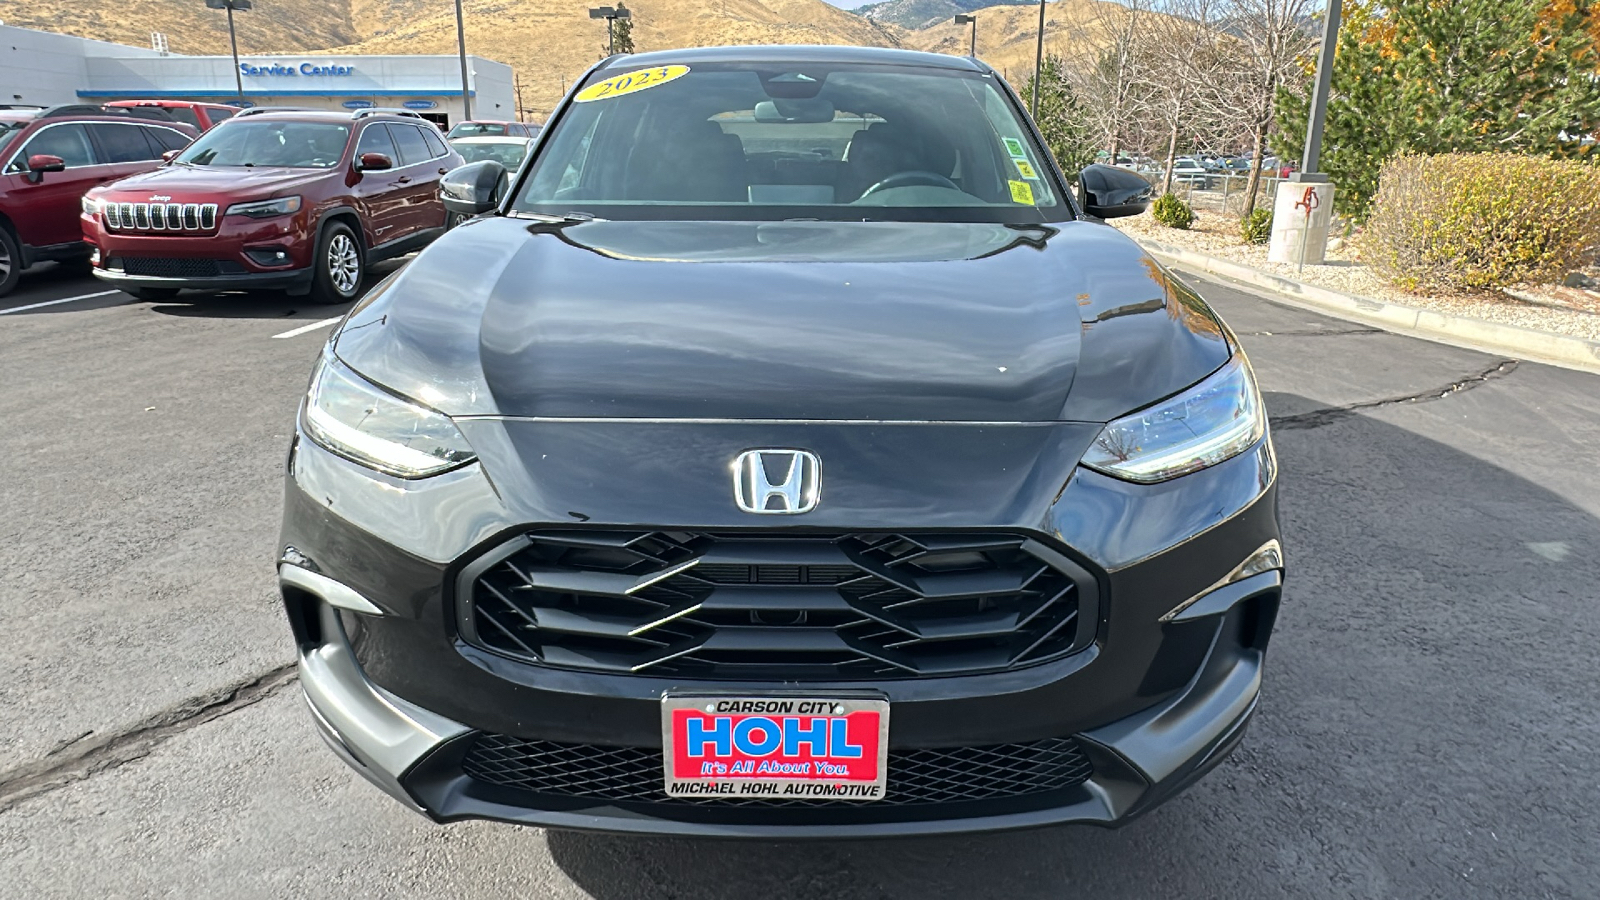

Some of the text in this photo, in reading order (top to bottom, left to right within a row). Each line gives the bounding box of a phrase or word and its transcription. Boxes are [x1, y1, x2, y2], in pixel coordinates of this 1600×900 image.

[240, 63, 354, 76] Service Center
[596, 68, 669, 97] 2023
[148, 194, 172, 203] Jeep
[716, 701, 840, 714] CARSON CITY
[686, 717, 863, 758] HOHL
[701, 760, 850, 775] It's All About You.
[671, 782, 880, 796] MICHAEL HOHL AUTOMOTIVE
